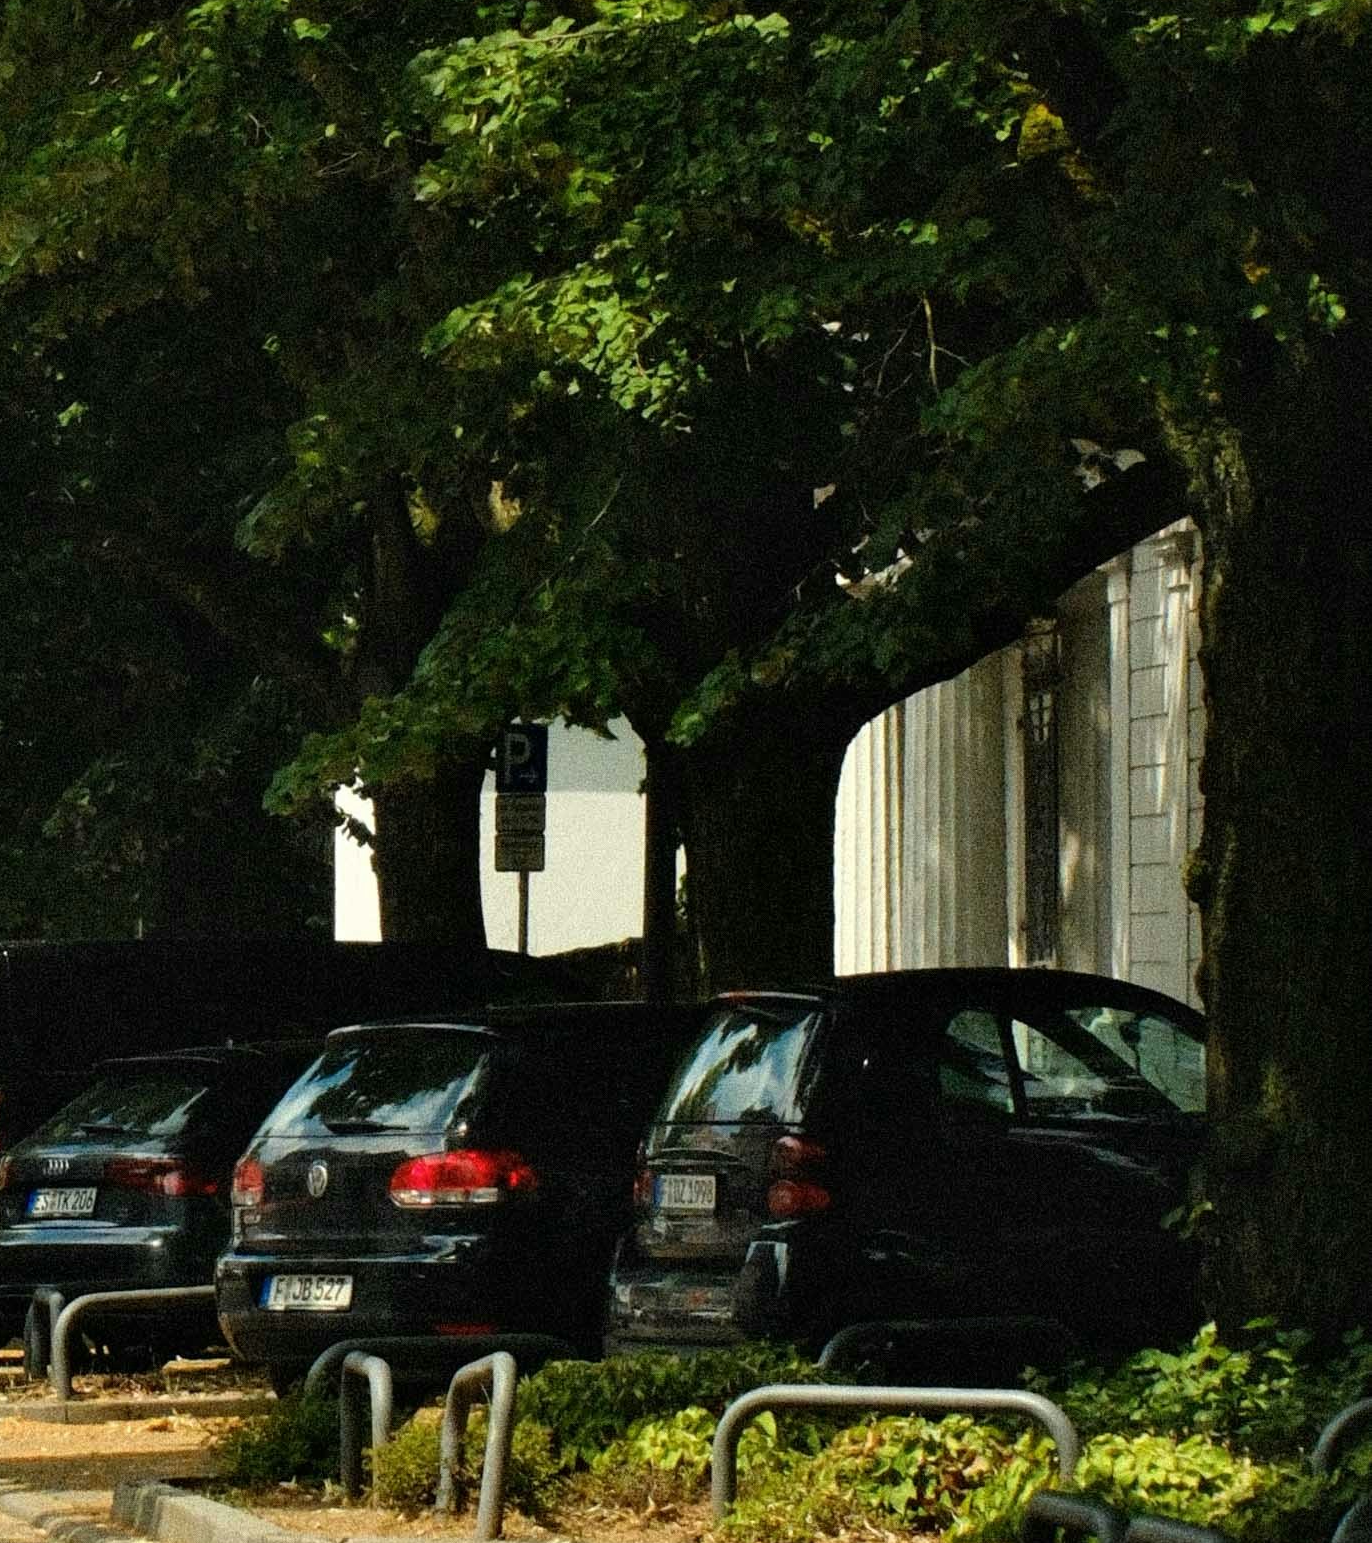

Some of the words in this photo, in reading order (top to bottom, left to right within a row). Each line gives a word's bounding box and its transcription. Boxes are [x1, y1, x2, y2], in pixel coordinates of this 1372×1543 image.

[503, 731, 531, 784] P
[56, 1190, 72, 1210] TK
[71, 1190, 94, 1210] 206
[273, 1276, 286, 1302] F
[292, 1276, 313, 1301] JB
[314, 1276, 347, 1301] 527
